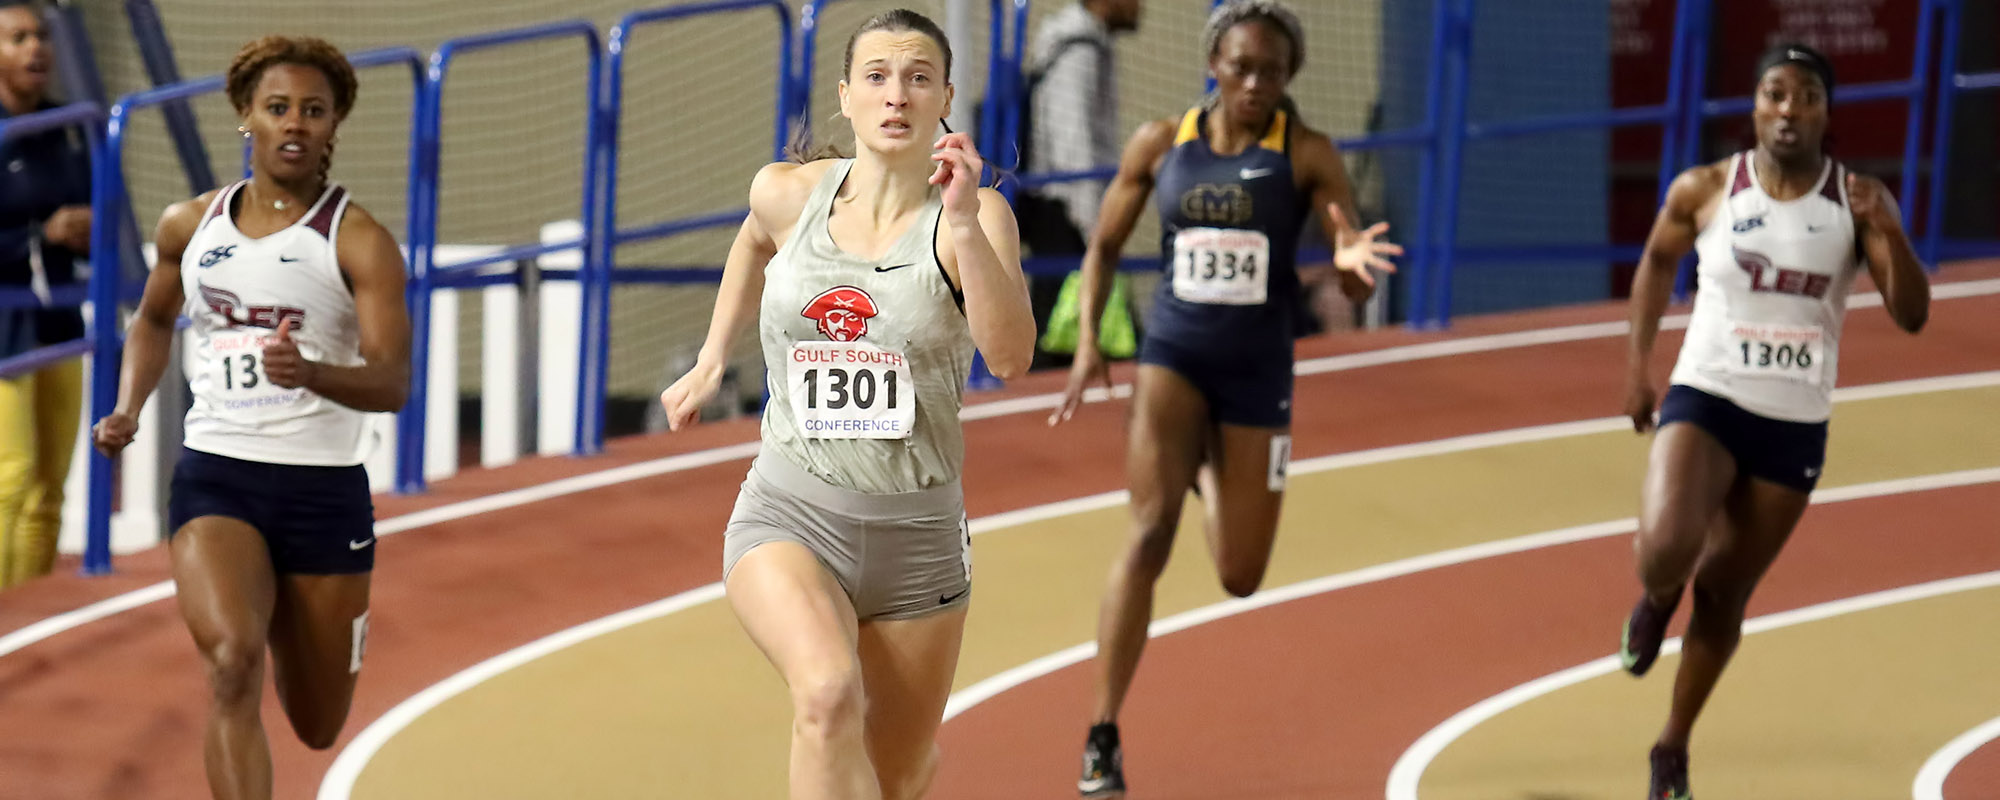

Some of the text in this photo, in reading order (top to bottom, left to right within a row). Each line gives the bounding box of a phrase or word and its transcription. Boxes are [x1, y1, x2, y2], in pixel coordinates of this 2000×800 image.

[1189, 251, 1255, 280] 1334
[1738, 252, 1831, 299] LEE
[793, 349, 902, 366] GULF SOUTH
[1741, 341, 1811, 368] 1306
[223, 354, 258, 389] 13
[804, 368, 897, 409] 1301
[805, 419, 899, 431] CONFERENCE
